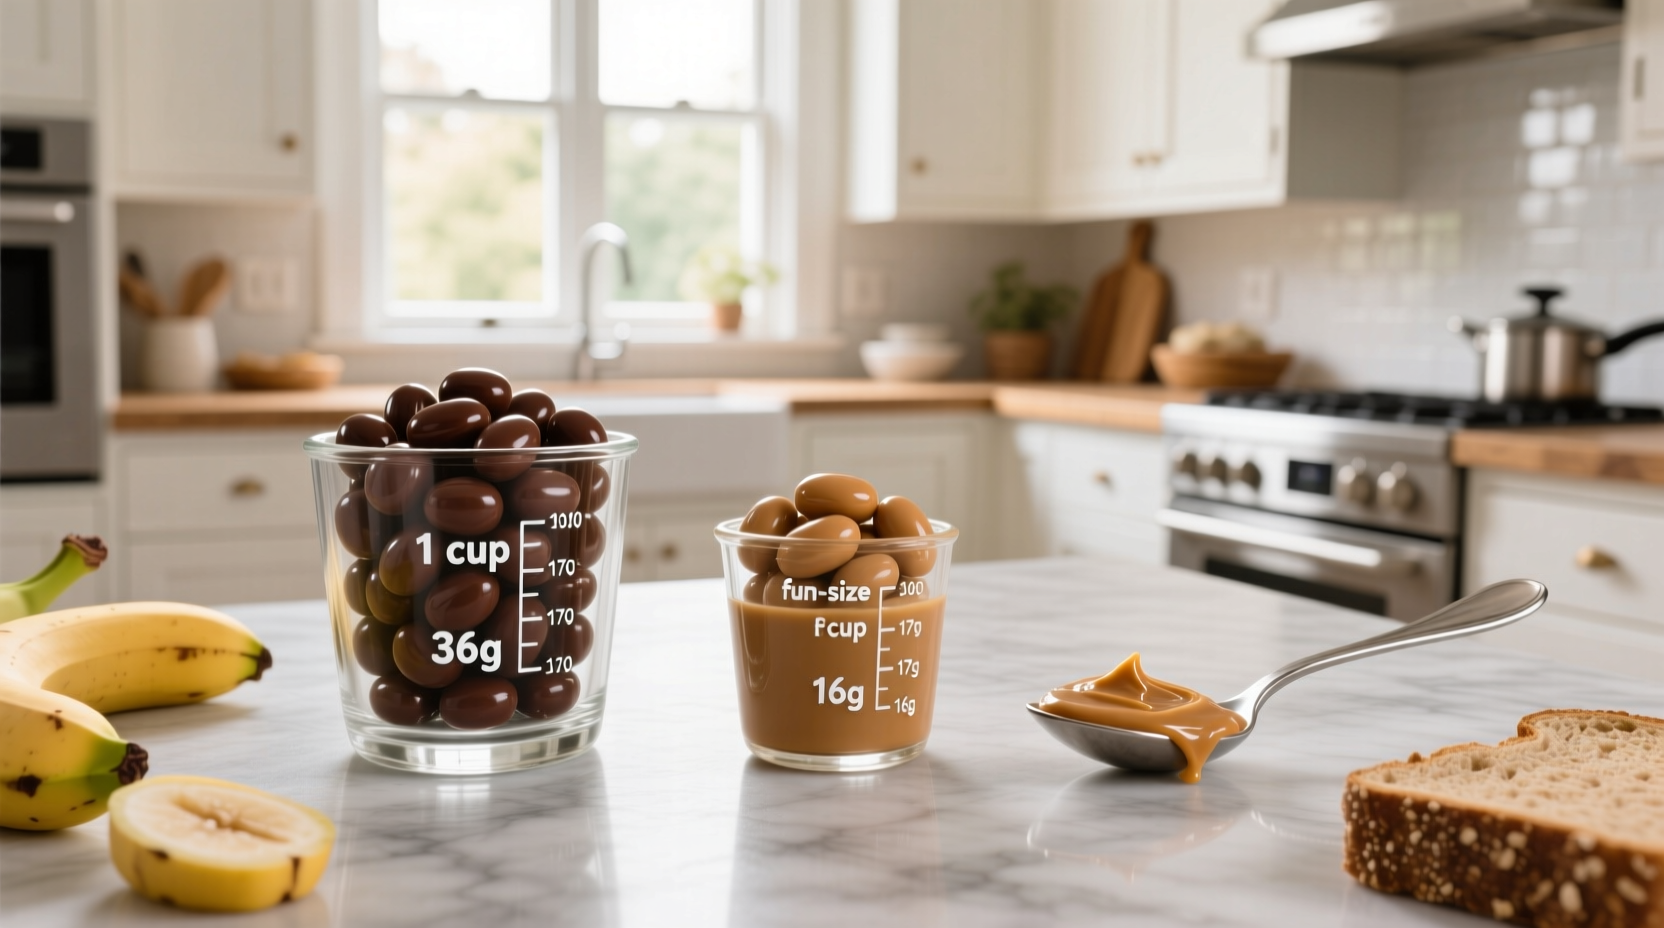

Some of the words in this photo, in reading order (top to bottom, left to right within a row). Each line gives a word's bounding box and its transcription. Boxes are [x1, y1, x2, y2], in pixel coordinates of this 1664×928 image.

[416, 533, 432, 565] 1
[446, 541, 510, 573] cup
[548, 559, 575, 576] 170
[782, 578, 871, 602] fun-size
[547, 608, 574, 625] 170
[431, 631, 502, 672] 36g
[545, 656, 573, 675] 170
[897, 659, 920, 678] 17g
[812, 677, 865, 712] 16g
